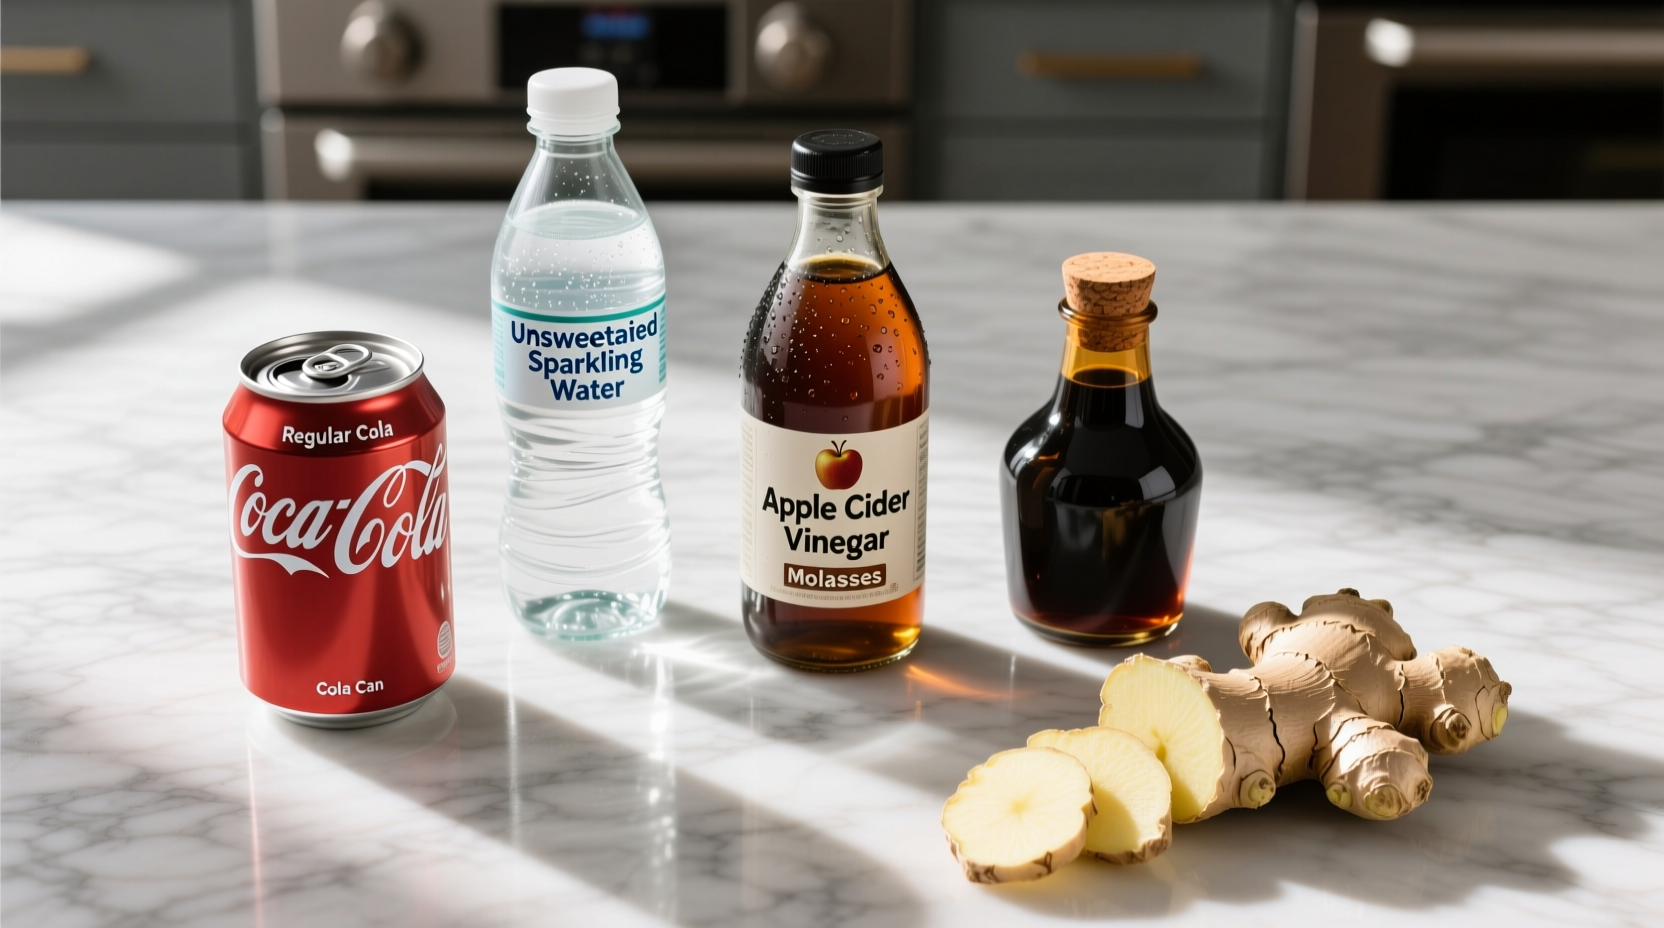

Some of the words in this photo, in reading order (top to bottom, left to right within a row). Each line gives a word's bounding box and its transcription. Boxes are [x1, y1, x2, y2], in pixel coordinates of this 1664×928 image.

[511, 312, 658, 349] Unsweetaied
[528, 348, 643, 380] Sparkling
[550, 378, 625, 401] Water
[282, 425, 351, 449] Regular
[356, 420, 393, 440] Cola
[228, 443, 448, 578] Coca-Cola
[762, 486, 837, 525] Apple
[844, 489, 910, 520] Cider
[783, 525, 890, 561] Vinegar
[787, 566, 882, 588] Molasses
[316, 681, 351, 696] Cola
[355, 680, 384, 694] Can
